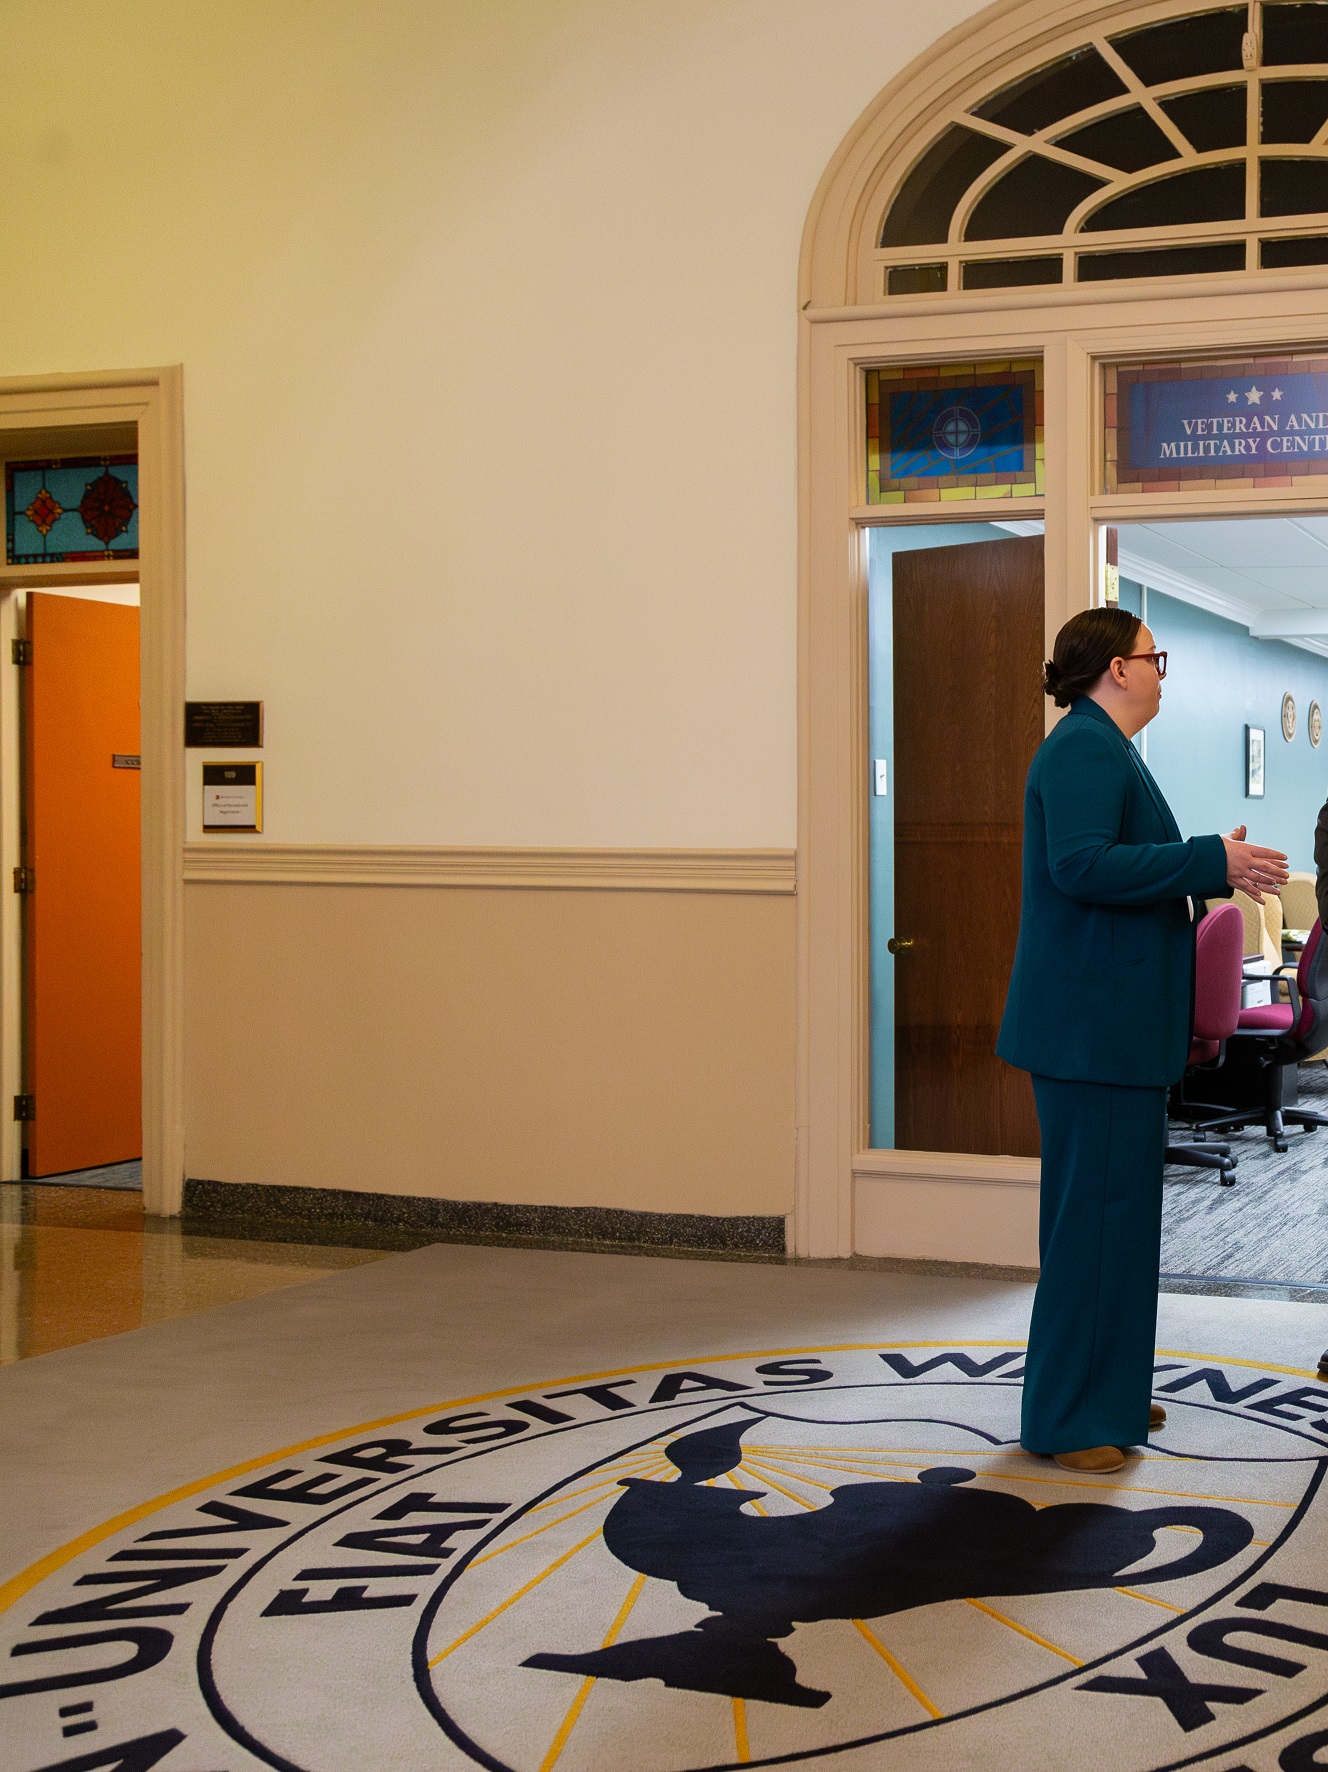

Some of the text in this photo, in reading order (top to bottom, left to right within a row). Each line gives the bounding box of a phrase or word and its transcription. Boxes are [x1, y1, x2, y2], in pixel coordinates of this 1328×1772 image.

[1181, 414, 1280, 435] VETERAN
[1159, 437, 1261, 459] MILITARY
[259, 1492, 513, 1618] FIAT
